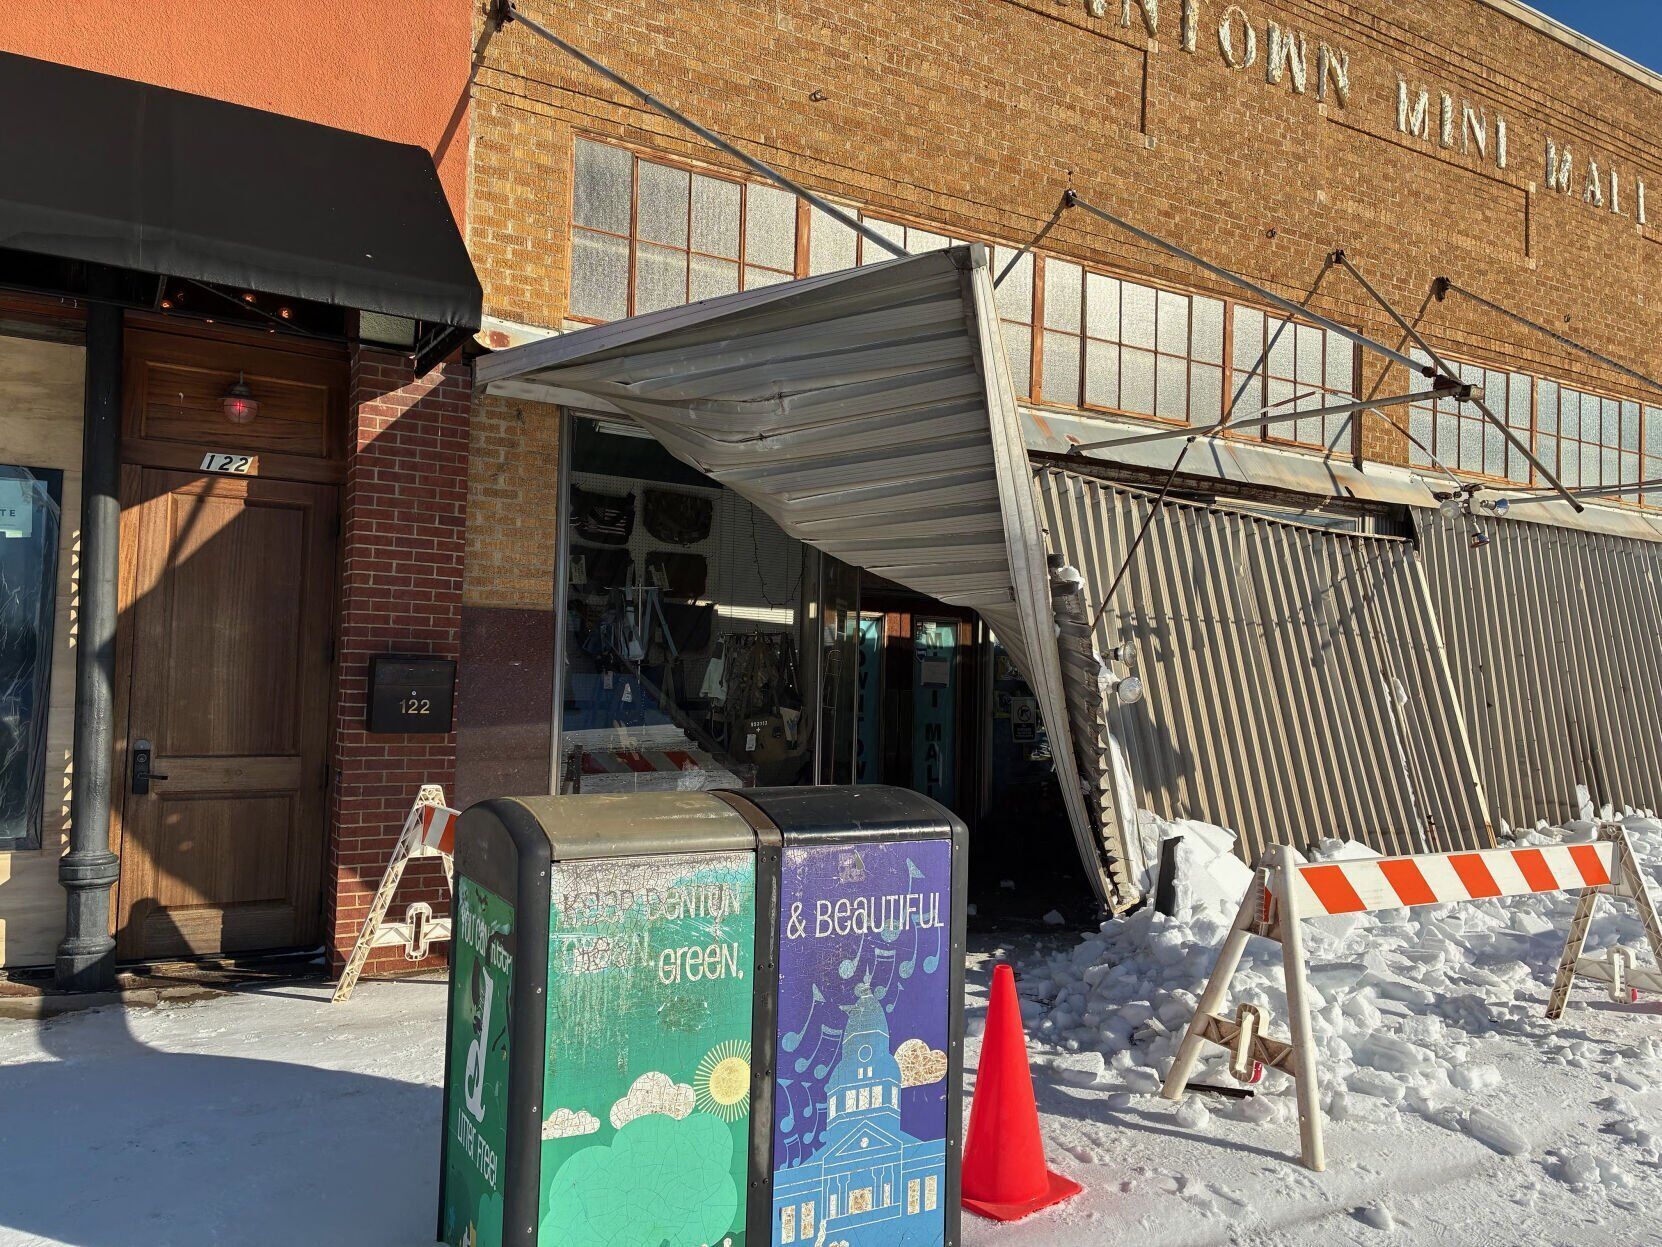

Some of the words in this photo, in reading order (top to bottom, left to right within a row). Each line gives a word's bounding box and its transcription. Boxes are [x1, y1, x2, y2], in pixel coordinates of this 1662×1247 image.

[1397, 72, 1507, 169] MINI
[206, 454, 249, 472] 122
[399, 699, 430, 714] 122
[786, 902, 806, 939] &
